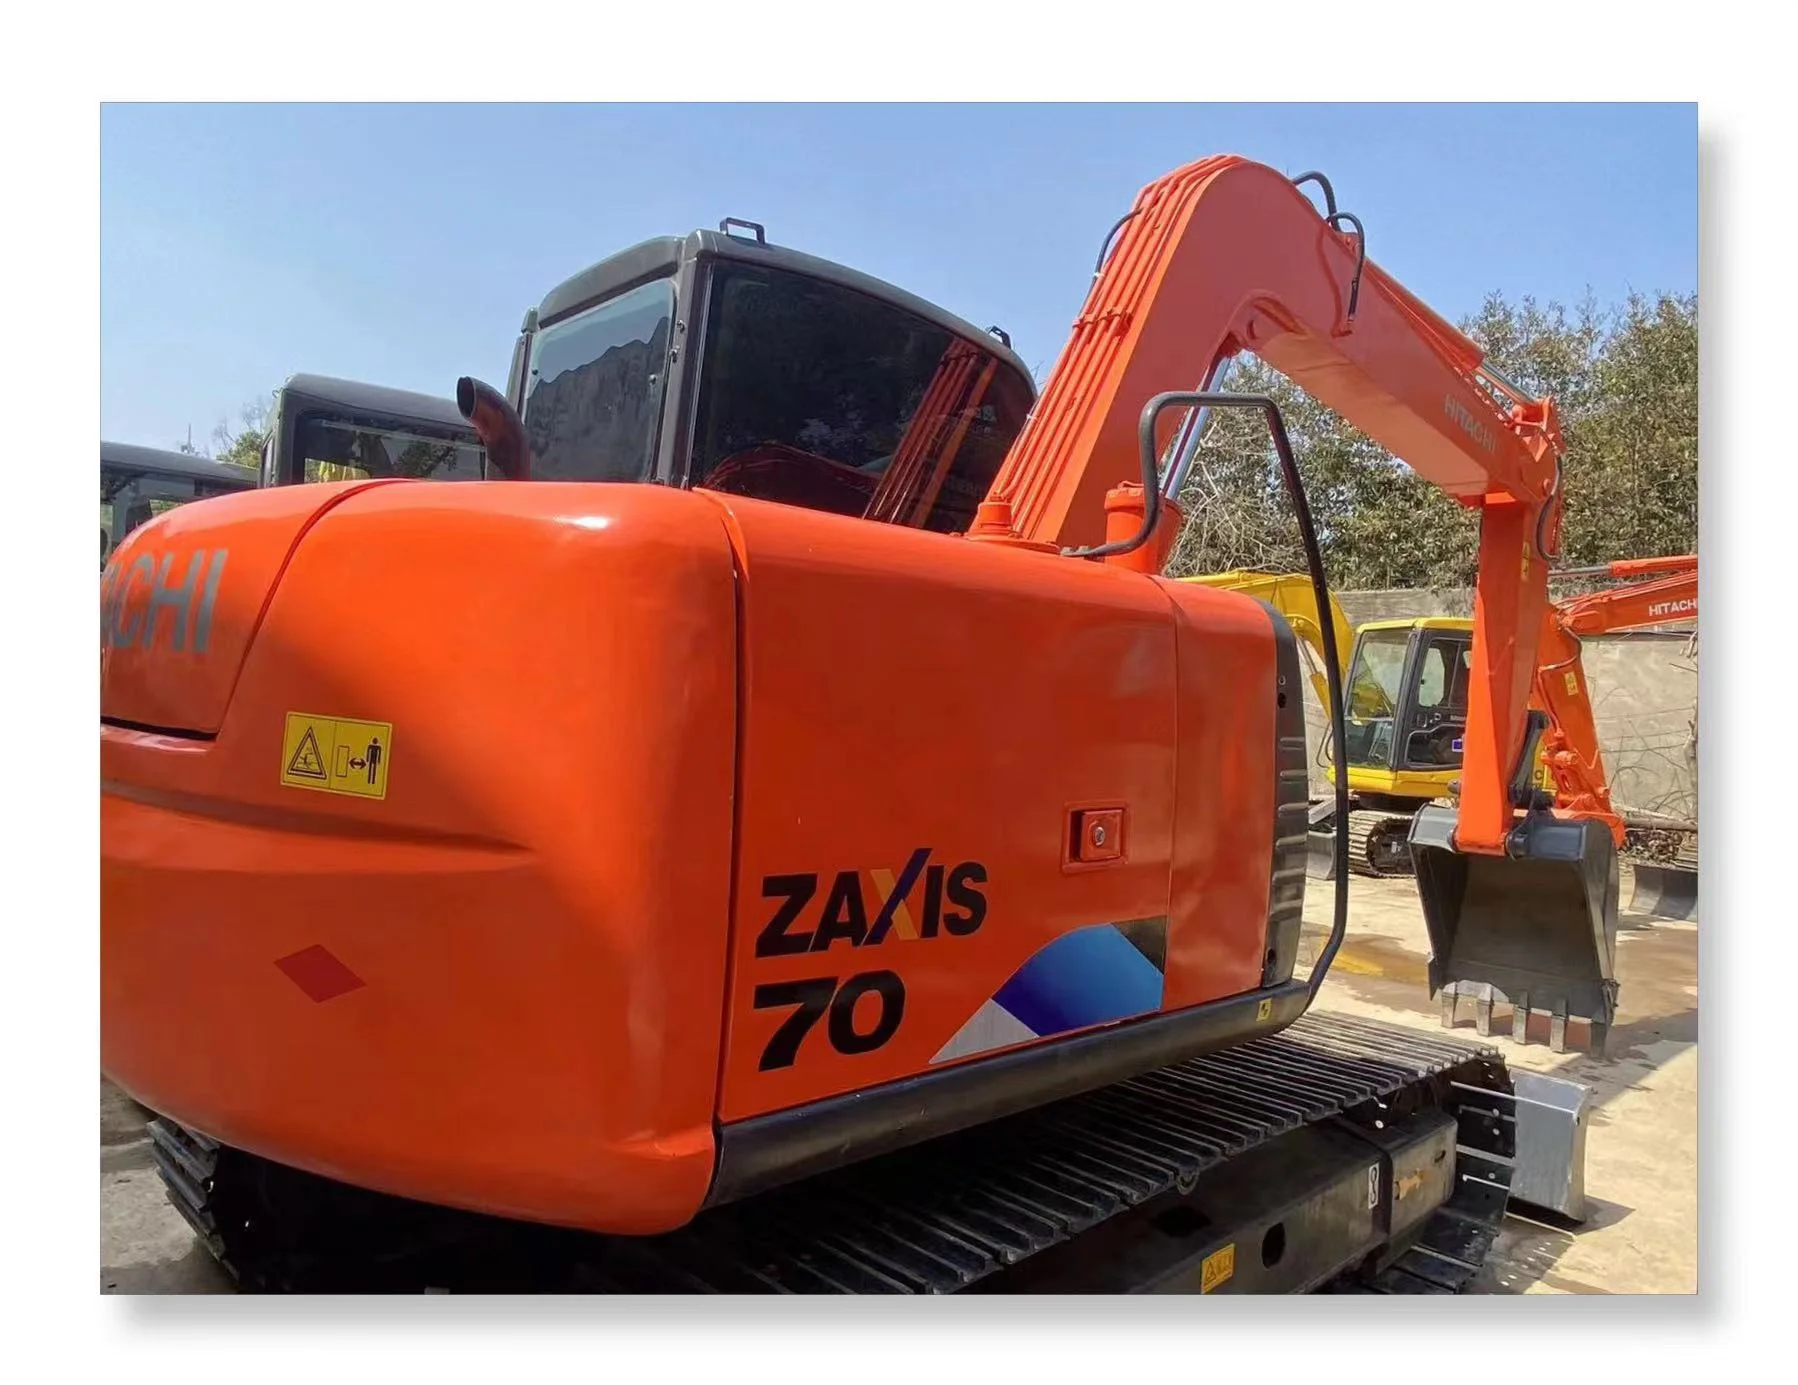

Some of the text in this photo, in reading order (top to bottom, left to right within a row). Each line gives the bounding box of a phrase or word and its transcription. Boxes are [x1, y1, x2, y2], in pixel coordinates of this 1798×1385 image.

[1444, 393, 1496, 453] HITACHI
[755, 848, 988, 958] ZAXIS
[753, 969, 905, 1073] 70
